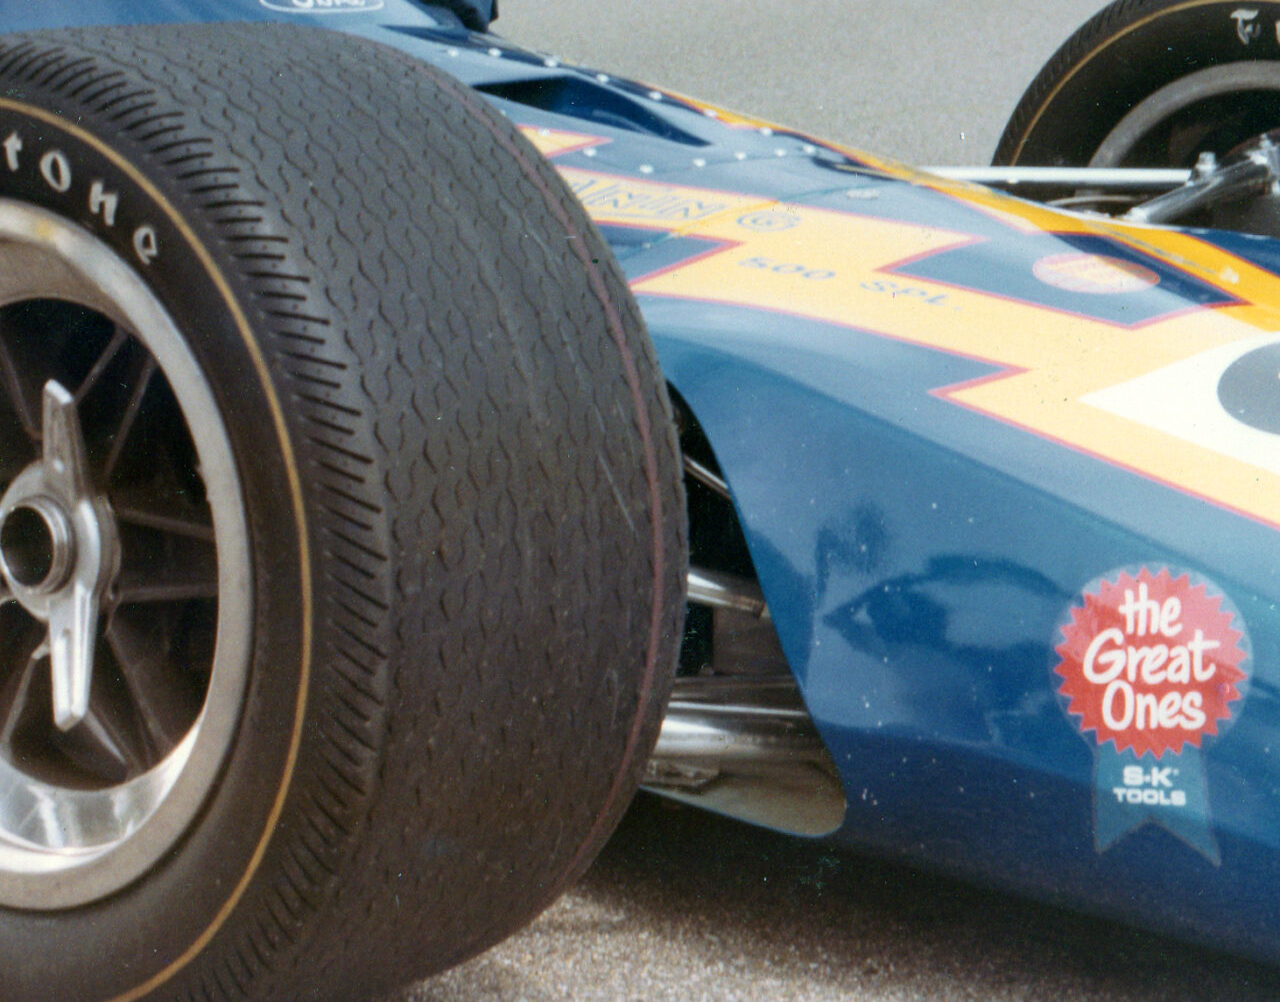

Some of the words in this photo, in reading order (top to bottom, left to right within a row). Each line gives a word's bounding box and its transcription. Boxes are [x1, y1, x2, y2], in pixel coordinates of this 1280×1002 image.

[737, 256, 836, 281] 500
[1119, 581, 1183, 637] the
[1082, 628, 1220, 685] Great
[1102, 679, 1206, 731] Ones
[1113, 787, 1187, 806] TOOLS
